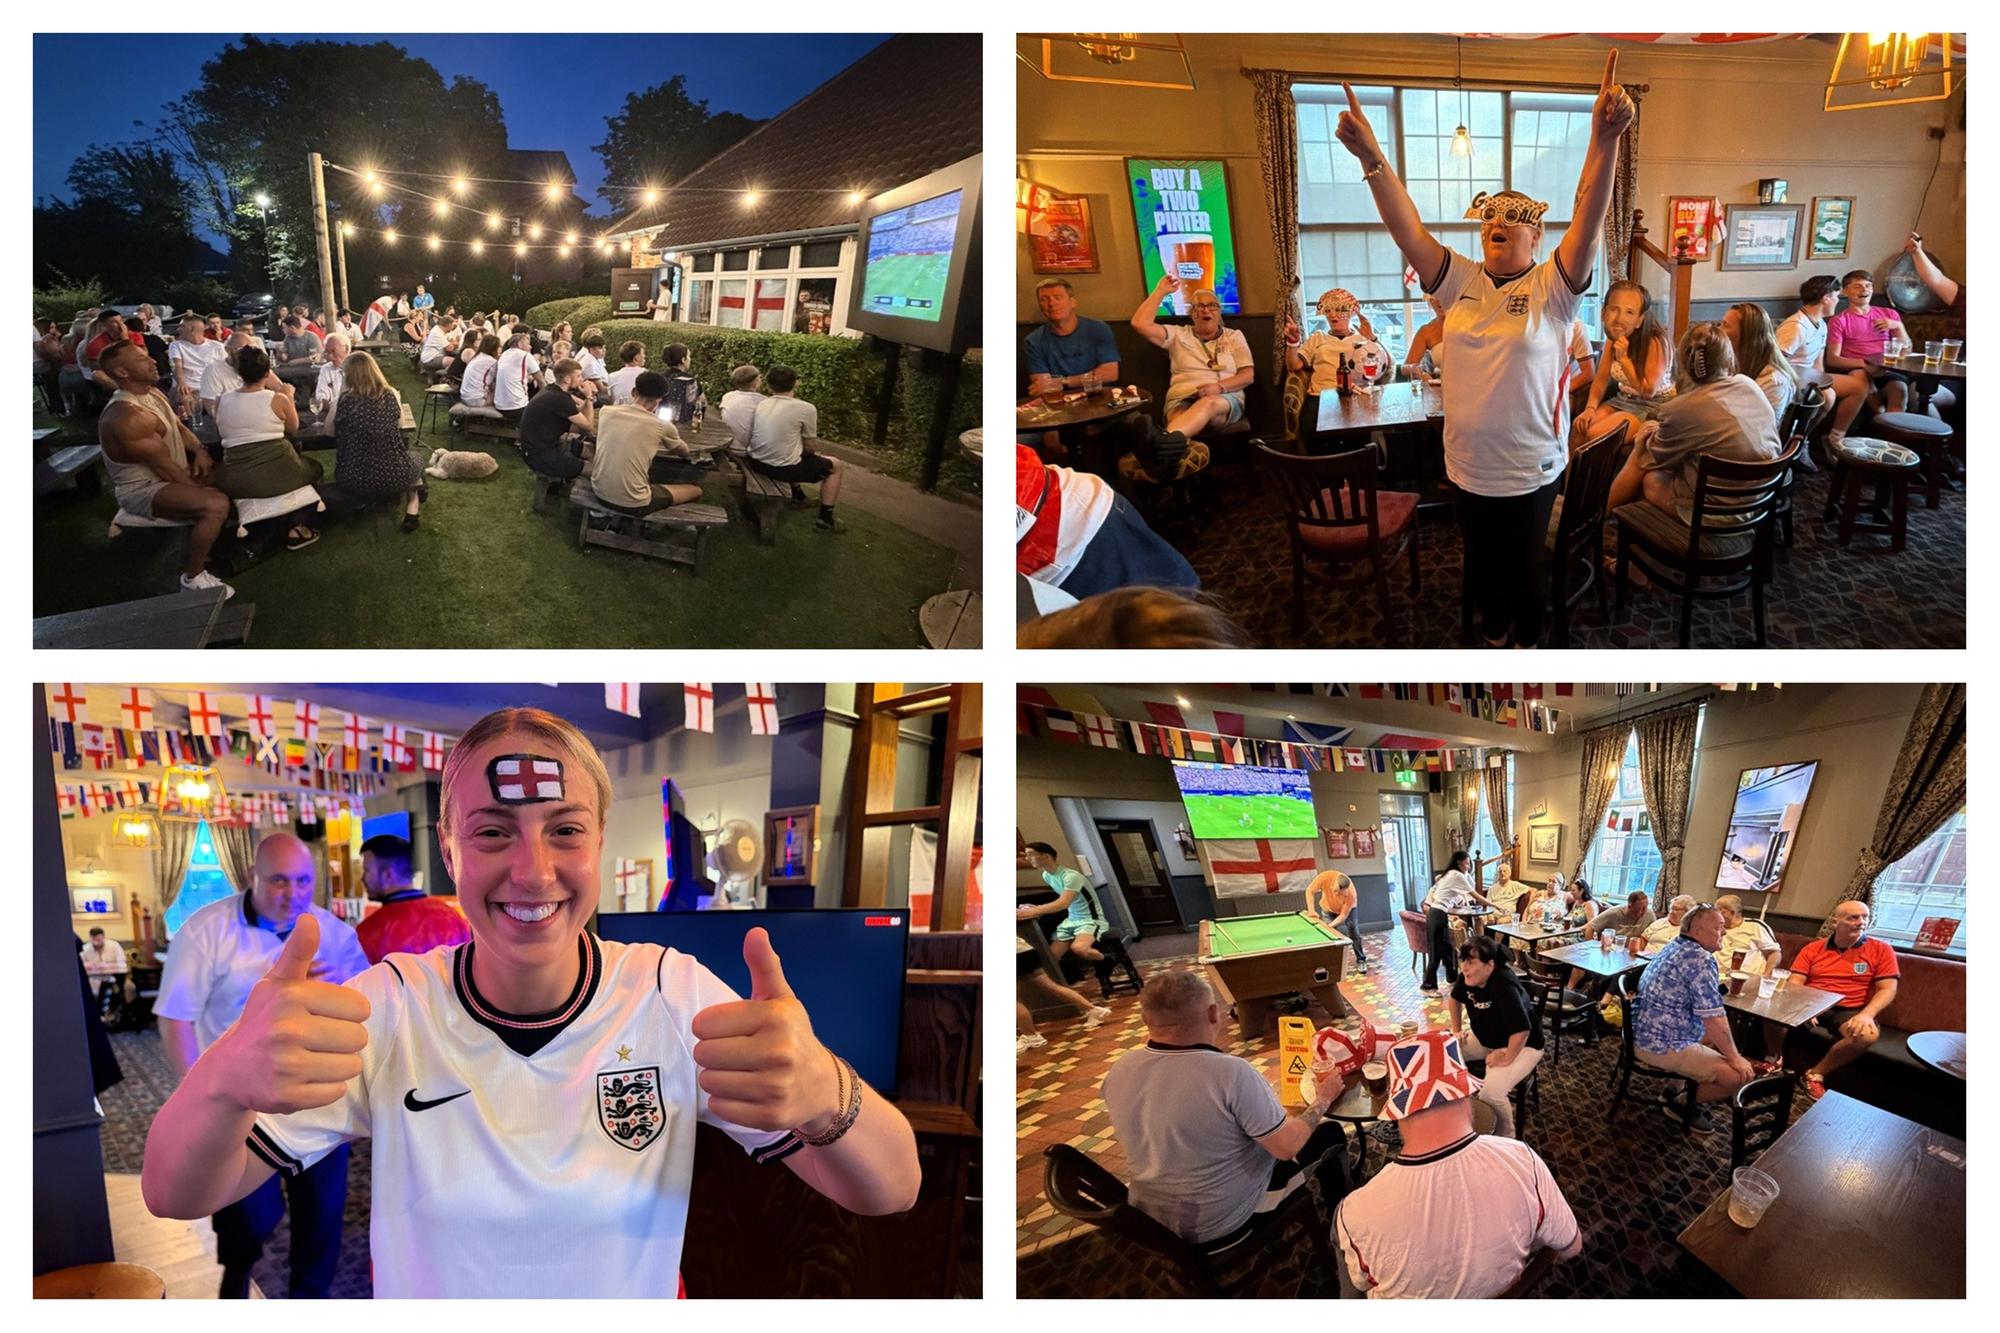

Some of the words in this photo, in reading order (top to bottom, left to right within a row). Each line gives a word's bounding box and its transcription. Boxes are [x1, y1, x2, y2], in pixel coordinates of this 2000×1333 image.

[1151, 169, 1184, 190] BUY
[1190, 169, 1203, 190] A
[1159, 191, 1200, 211] TWO
[1678, 201, 1709, 211] MORE
[1153, 212, 1212, 232] PINTER
